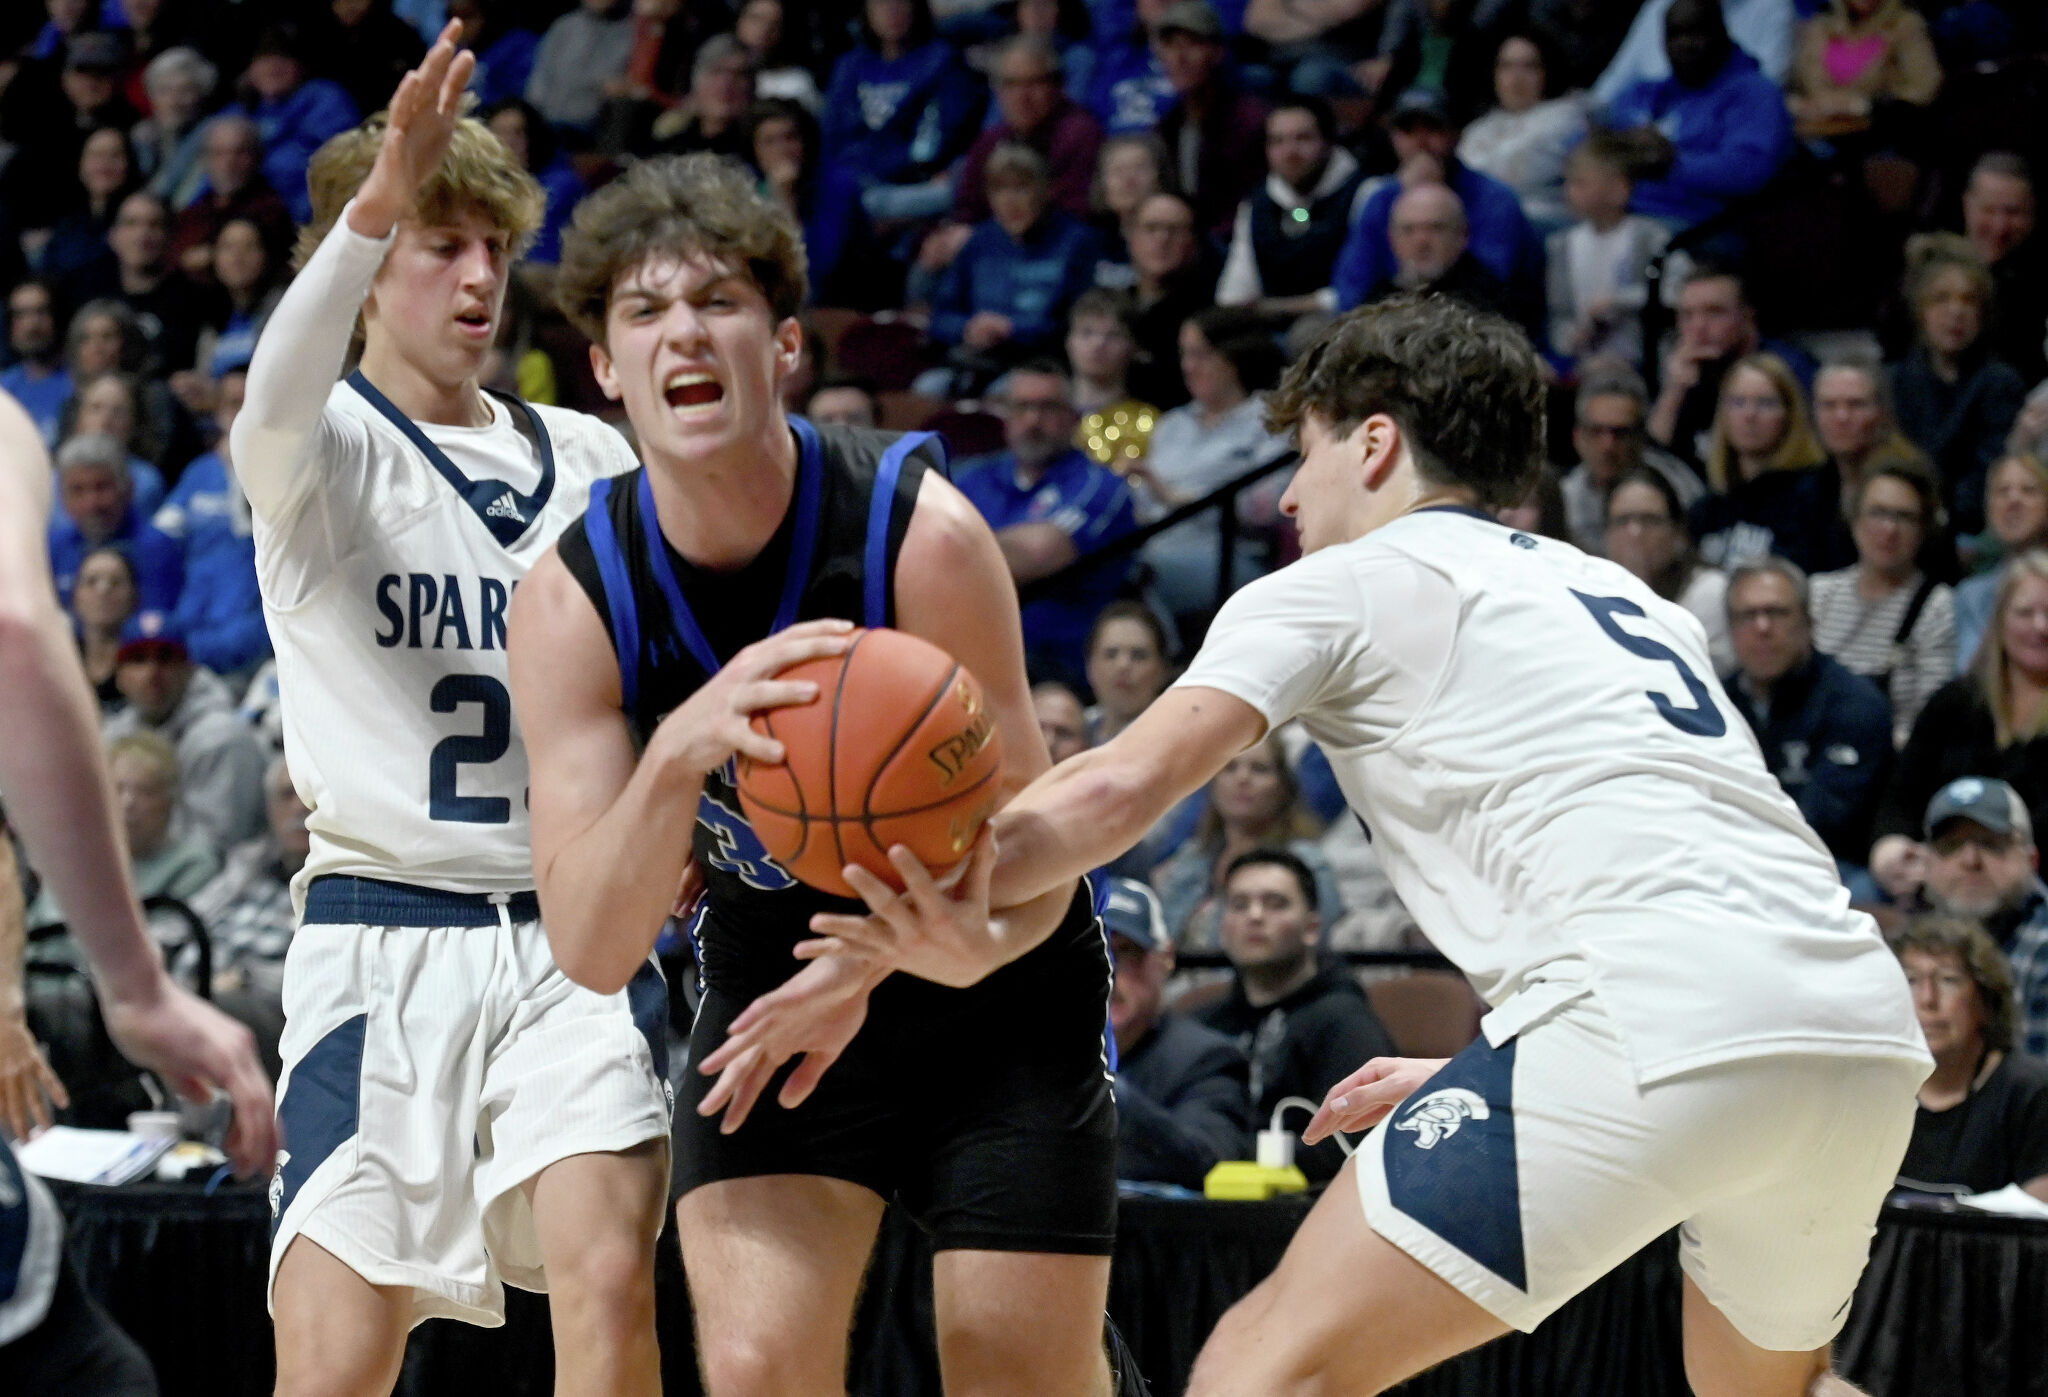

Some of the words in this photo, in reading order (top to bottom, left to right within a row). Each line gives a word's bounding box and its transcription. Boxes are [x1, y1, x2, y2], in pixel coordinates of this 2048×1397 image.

[375, 573, 518, 650] SPAR
[1567, 586, 1727, 738] 5
[429, 674, 530, 824] 2
